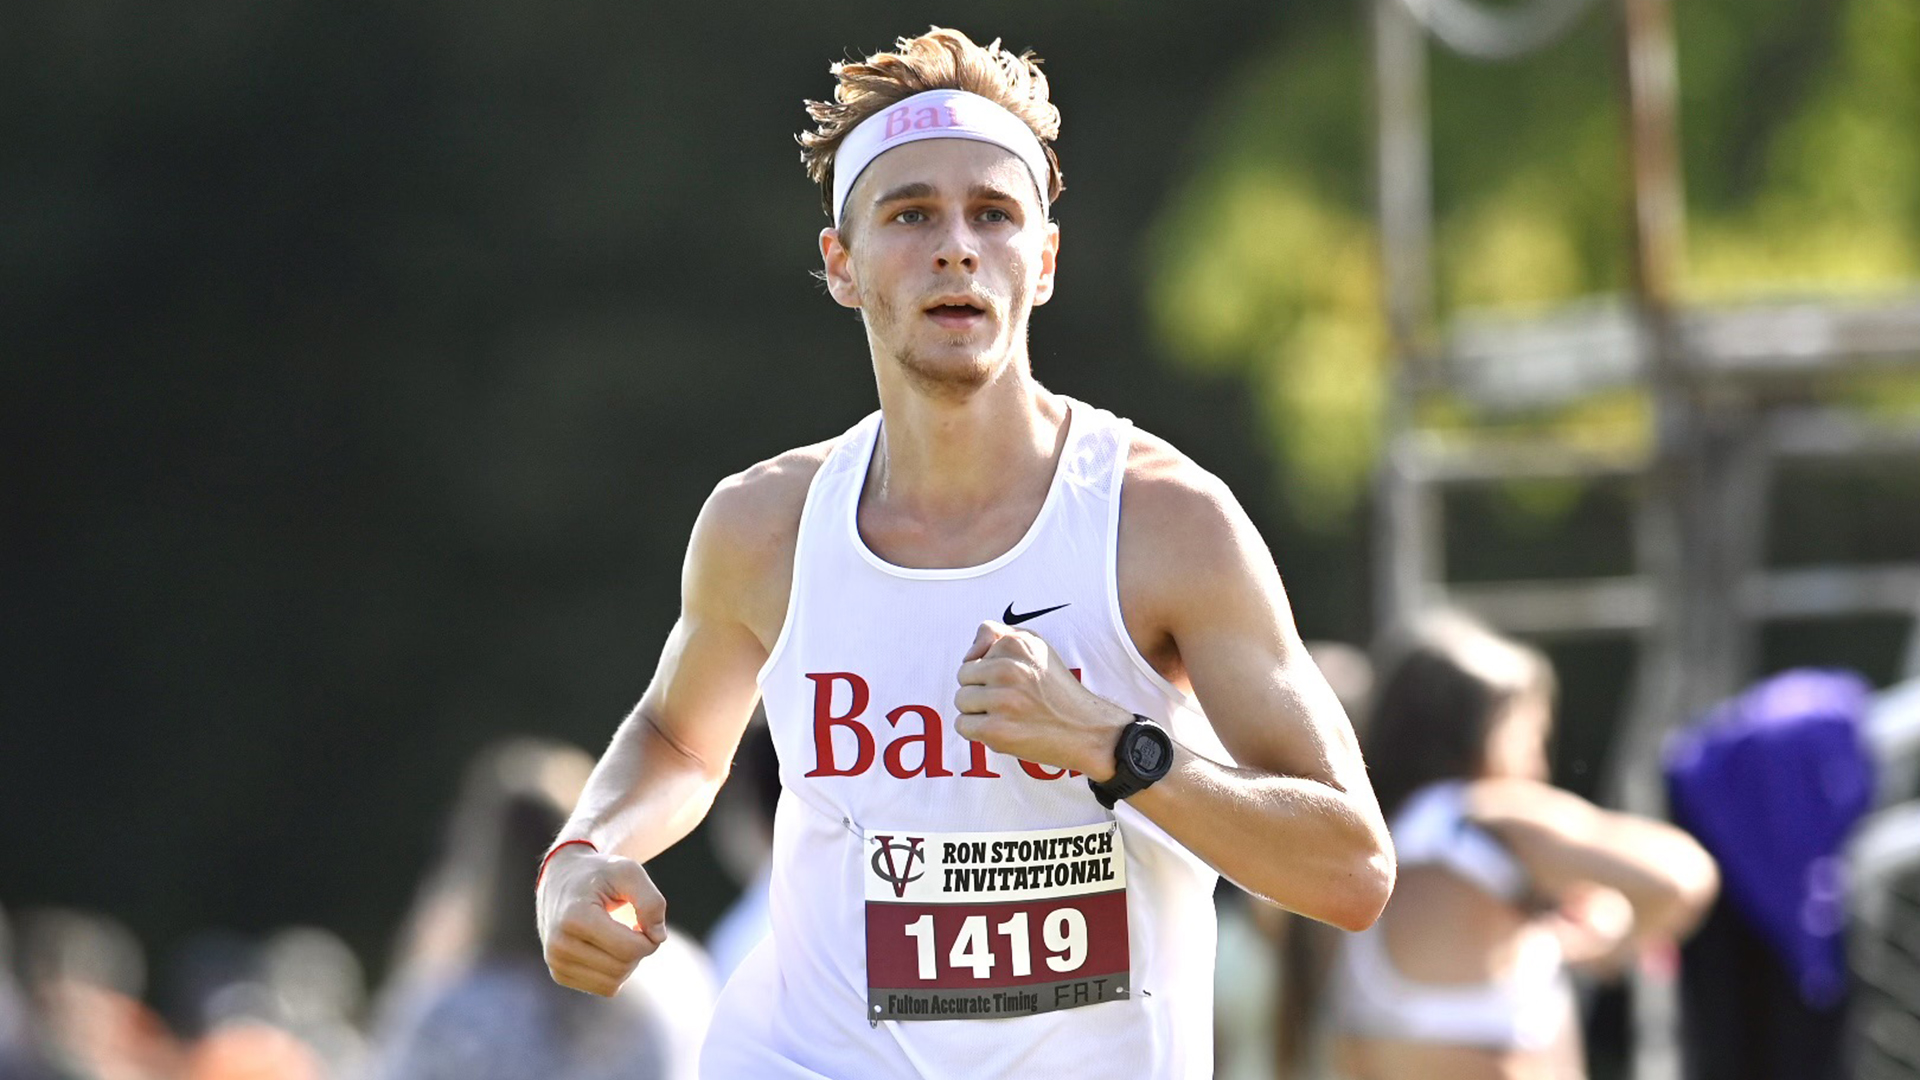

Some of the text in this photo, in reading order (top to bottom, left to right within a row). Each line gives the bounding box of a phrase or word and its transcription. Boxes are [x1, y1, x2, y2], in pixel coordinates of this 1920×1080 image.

[882, 105, 963, 142] Bar
[804, 668, 1087, 780] Ba
[942, 832, 1114, 864] RON STONITSCH
[943, 858, 1115, 892] INVITATIONAL
[905, 908, 1088, 980] 1419
[888, 979, 1108, 1014] Fulton Accurate Timing FAT
